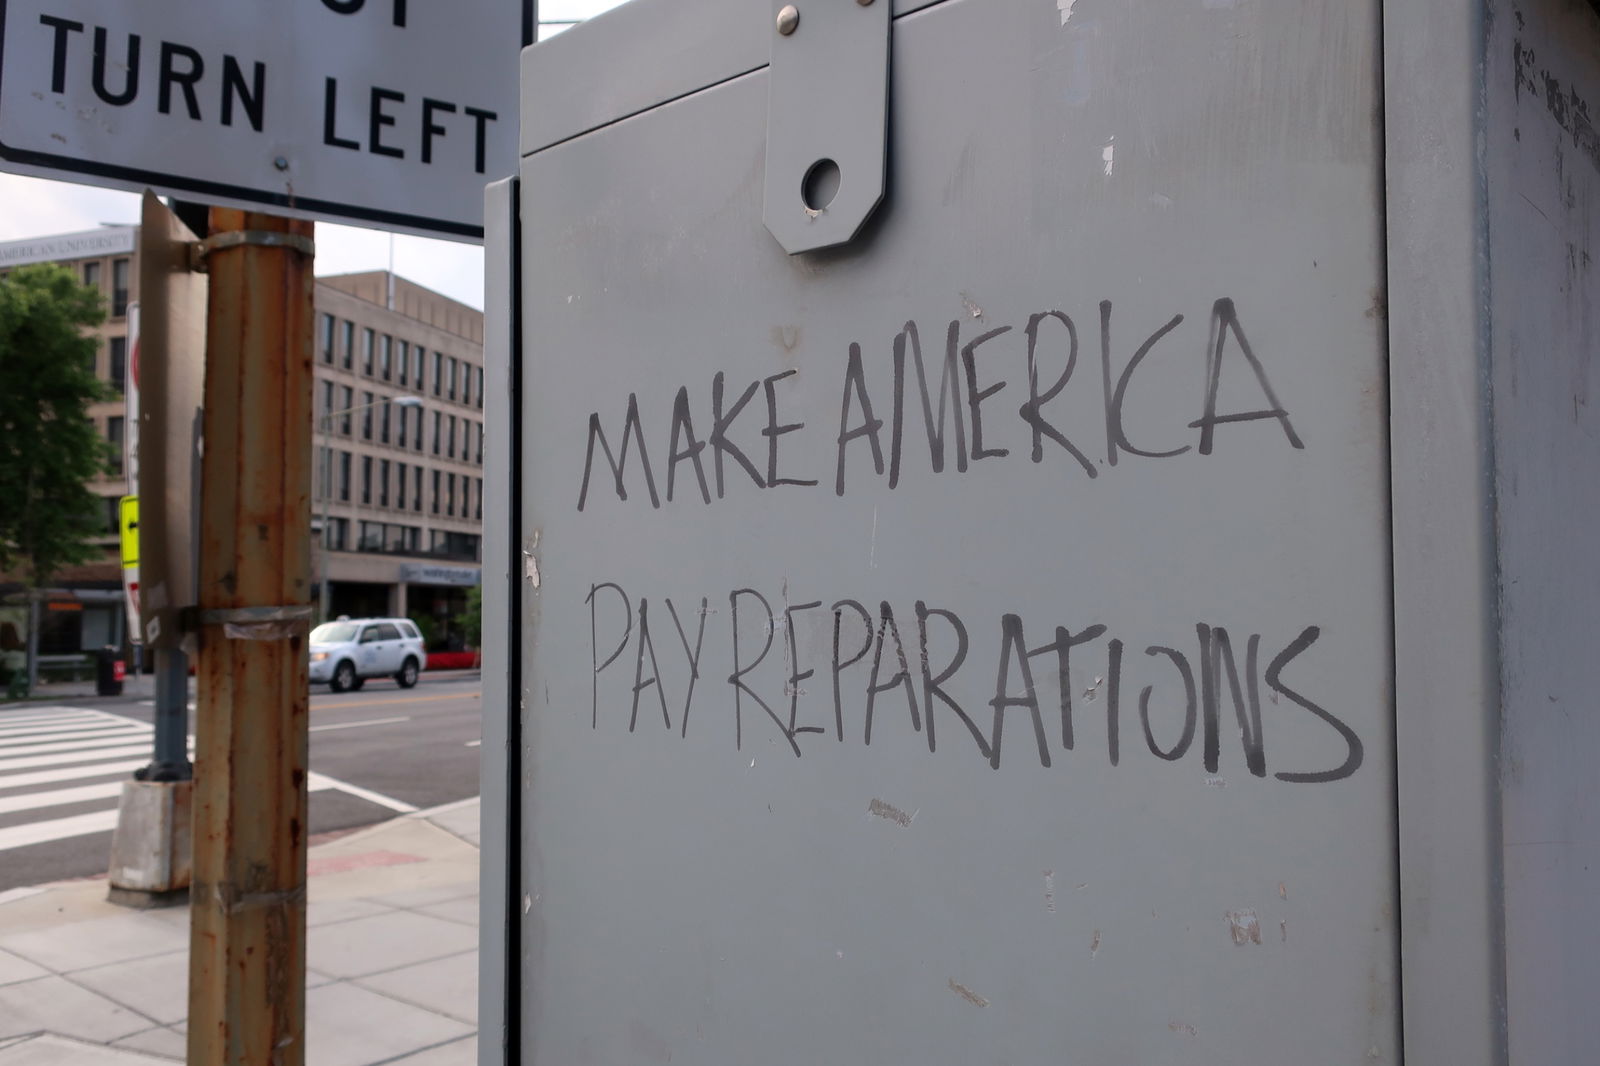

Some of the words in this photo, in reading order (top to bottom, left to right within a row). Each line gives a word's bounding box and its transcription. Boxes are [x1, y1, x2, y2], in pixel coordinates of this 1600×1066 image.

[40, 14, 267, 133] TURN
[323, 76, 498, 174] LEFT
[577, 369, 819, 511] MAKE
[835, 297, 1305, 497] AMERICA
[584, 582, 708, 739] PAY
[727, 587, 1364, 783] REPARATIONS
